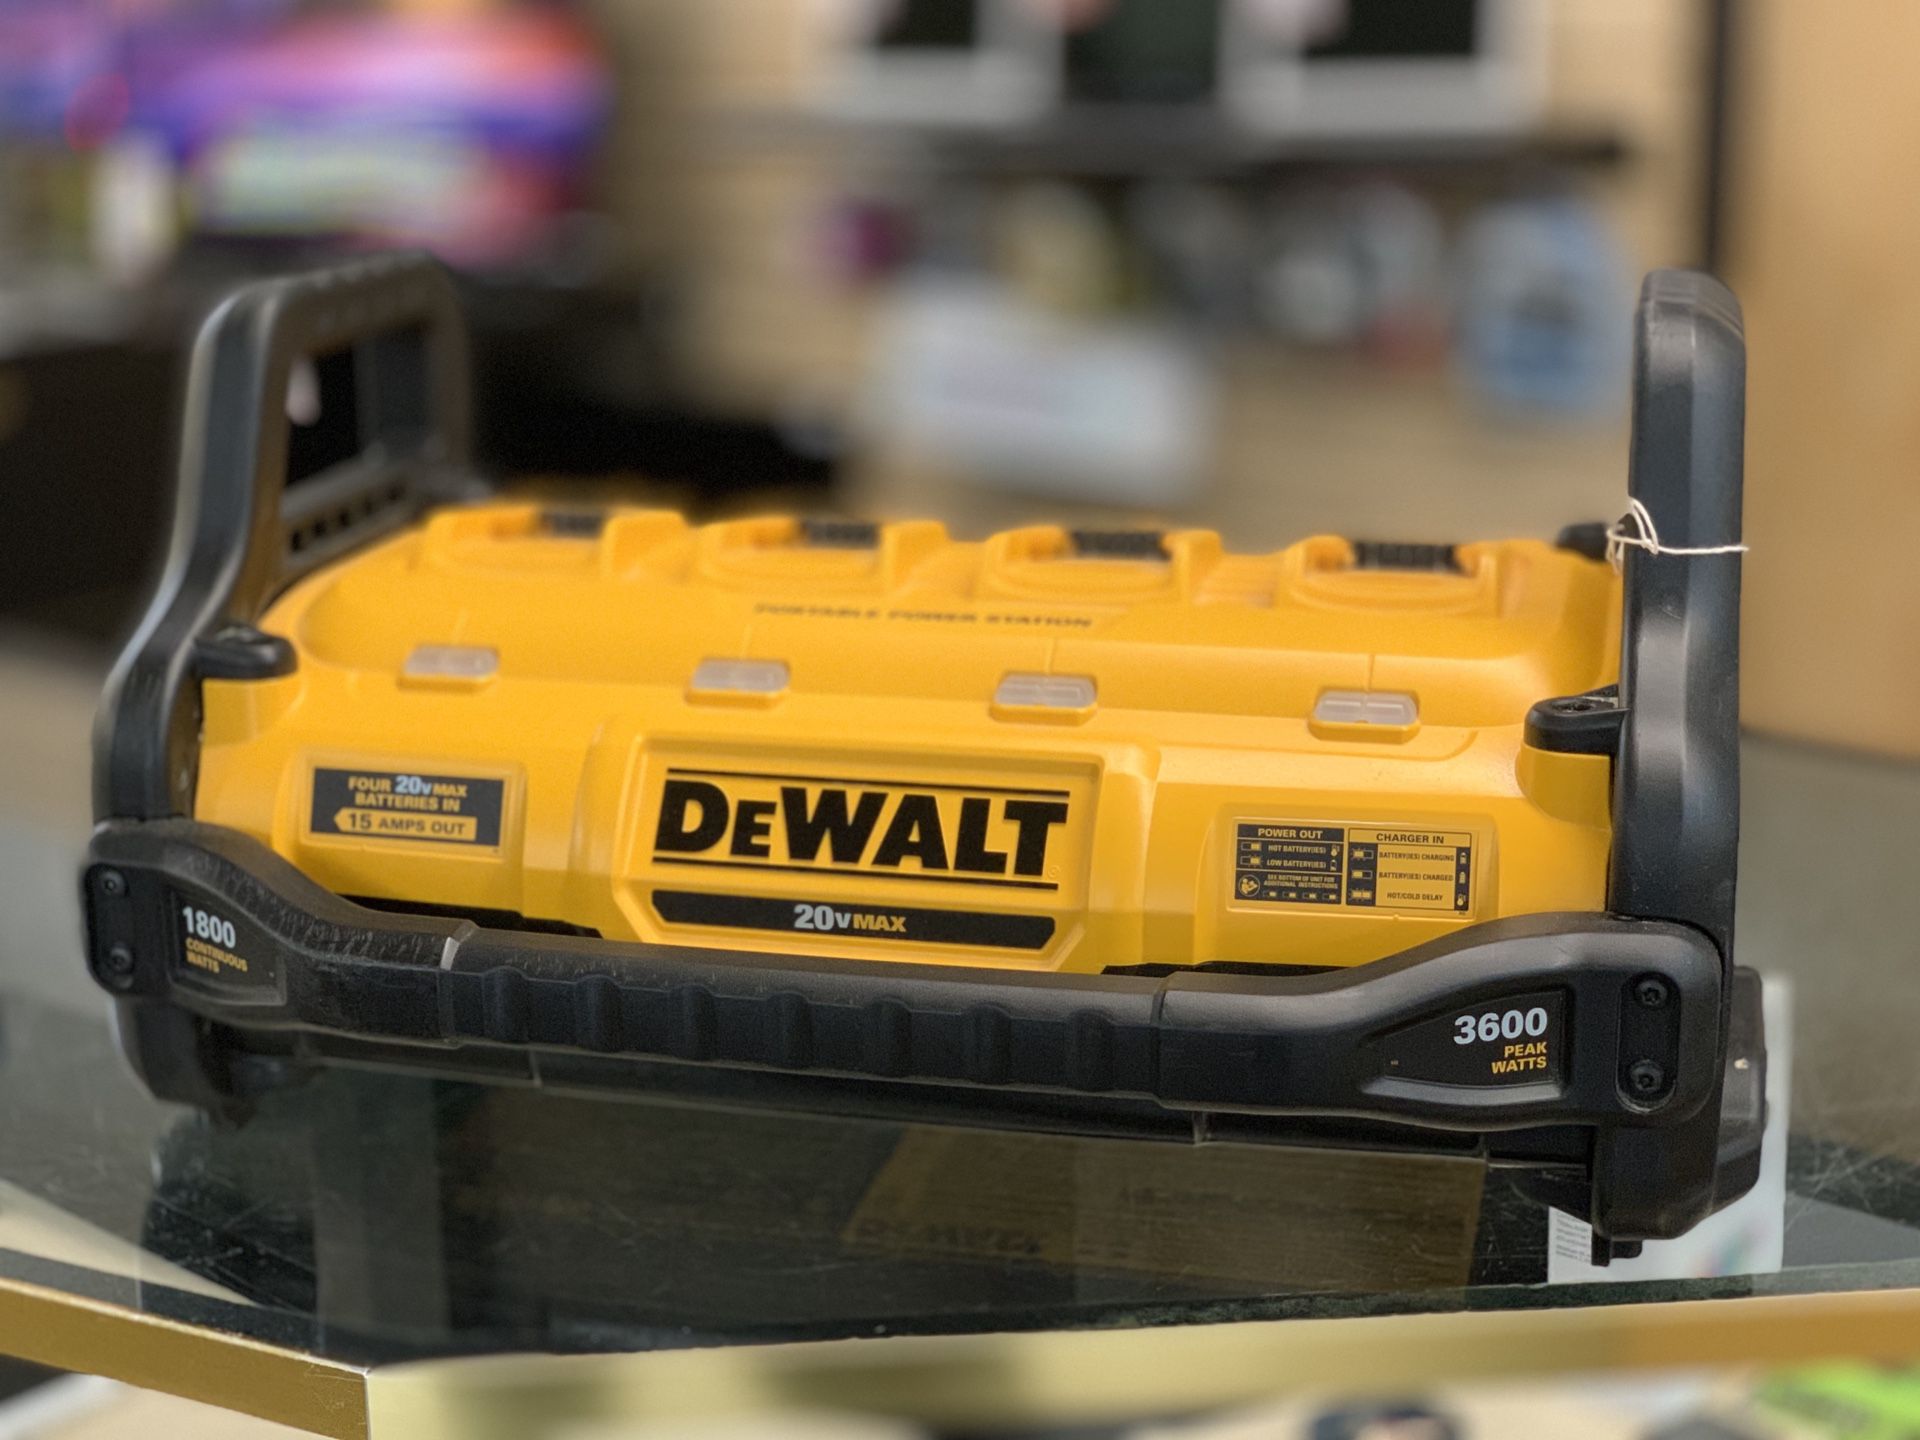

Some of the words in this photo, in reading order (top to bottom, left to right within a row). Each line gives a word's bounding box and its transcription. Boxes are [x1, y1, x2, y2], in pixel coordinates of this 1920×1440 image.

[348, 776, 391, 792] FOUR
[355, 792, 439, 811] BATTERIES
[442, 798, 461, 812] IN
[349, 813, 372, 830] 15
[378, 817, 426, 832] AMPS
[431, 820, 466, 835] OUT
[1257, 828, 1297, 838] POWER
[1299, 830, 1323, 839] OUT
[1376, 833, 1430, 843] CHARGER
[1432, 835, 1444, 844] IN
[1267, 844, 1282, 853] HOT
[1421, 852, 1455, 862] CHARGING
[1266, 858, 1282, 867] LOW
[1422, 873, 1453, 882] CHARGED
[1387, 892, 1420, 901] HOT/COLD
[182, 906, 237, 949] 1800
[852, 913, 907, 933] MAX
[185, 937, 249, 972] CONTINUOUS
[185, 949, 220, 974] WATTS
[1453, 1007, 1548, 1045] 3600
[1504, 1041, 1548, 1058] PEAK
[1491, 1056, 1547, 1074] WATTS
